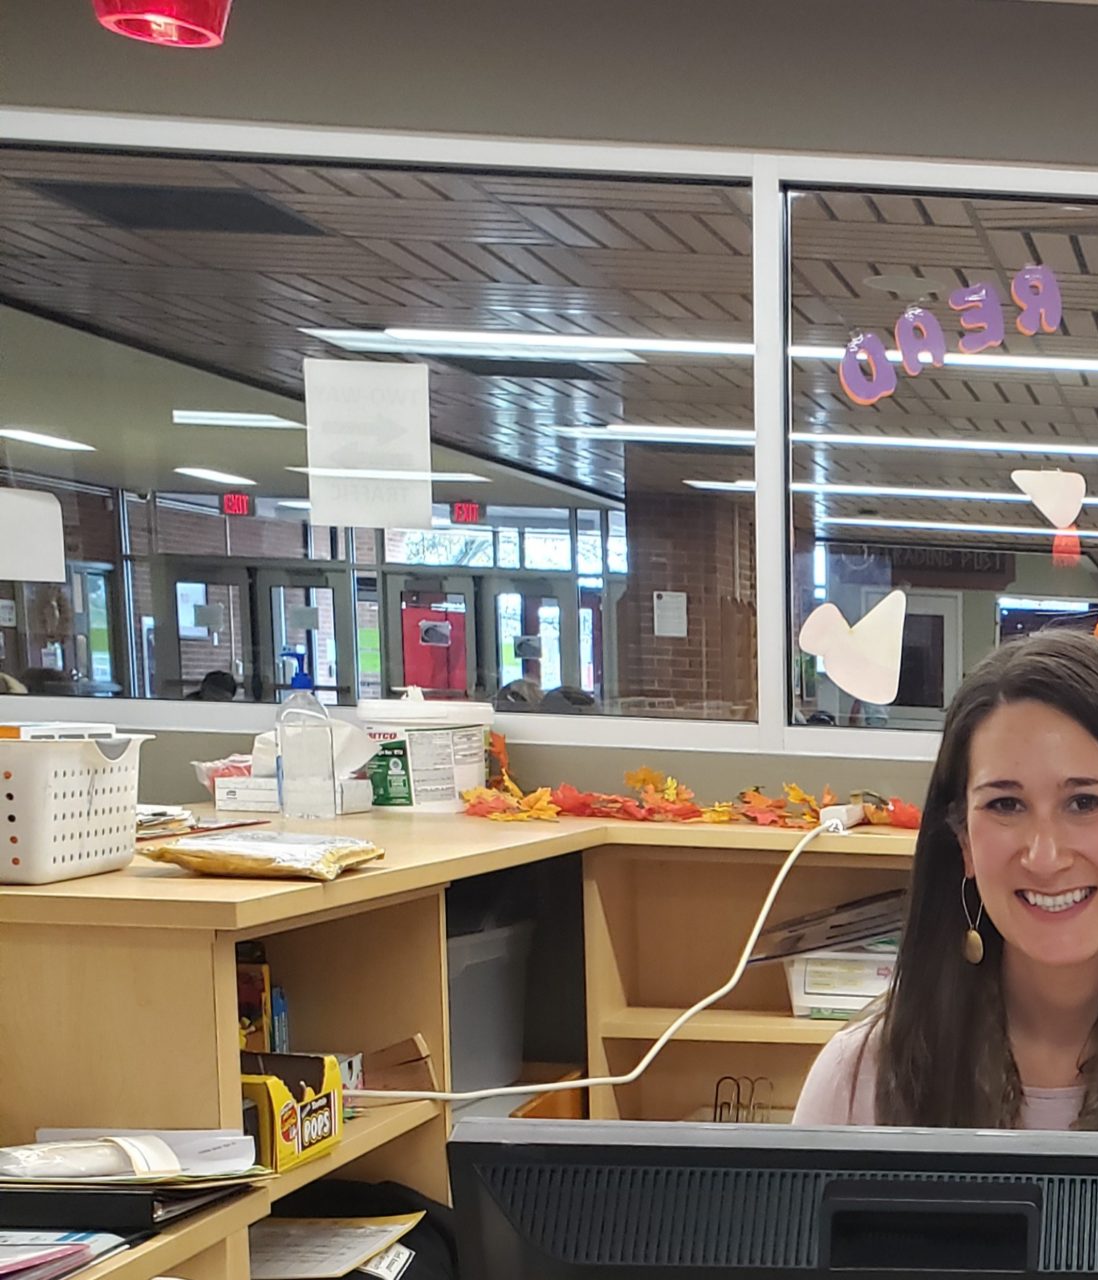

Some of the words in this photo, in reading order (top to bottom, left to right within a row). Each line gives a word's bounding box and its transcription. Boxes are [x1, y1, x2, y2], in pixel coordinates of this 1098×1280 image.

[223, 493, 249, 515] EXIT
[453, 502, 479, 523] EXIT
[303, 1107, 331, 1147] POPS
